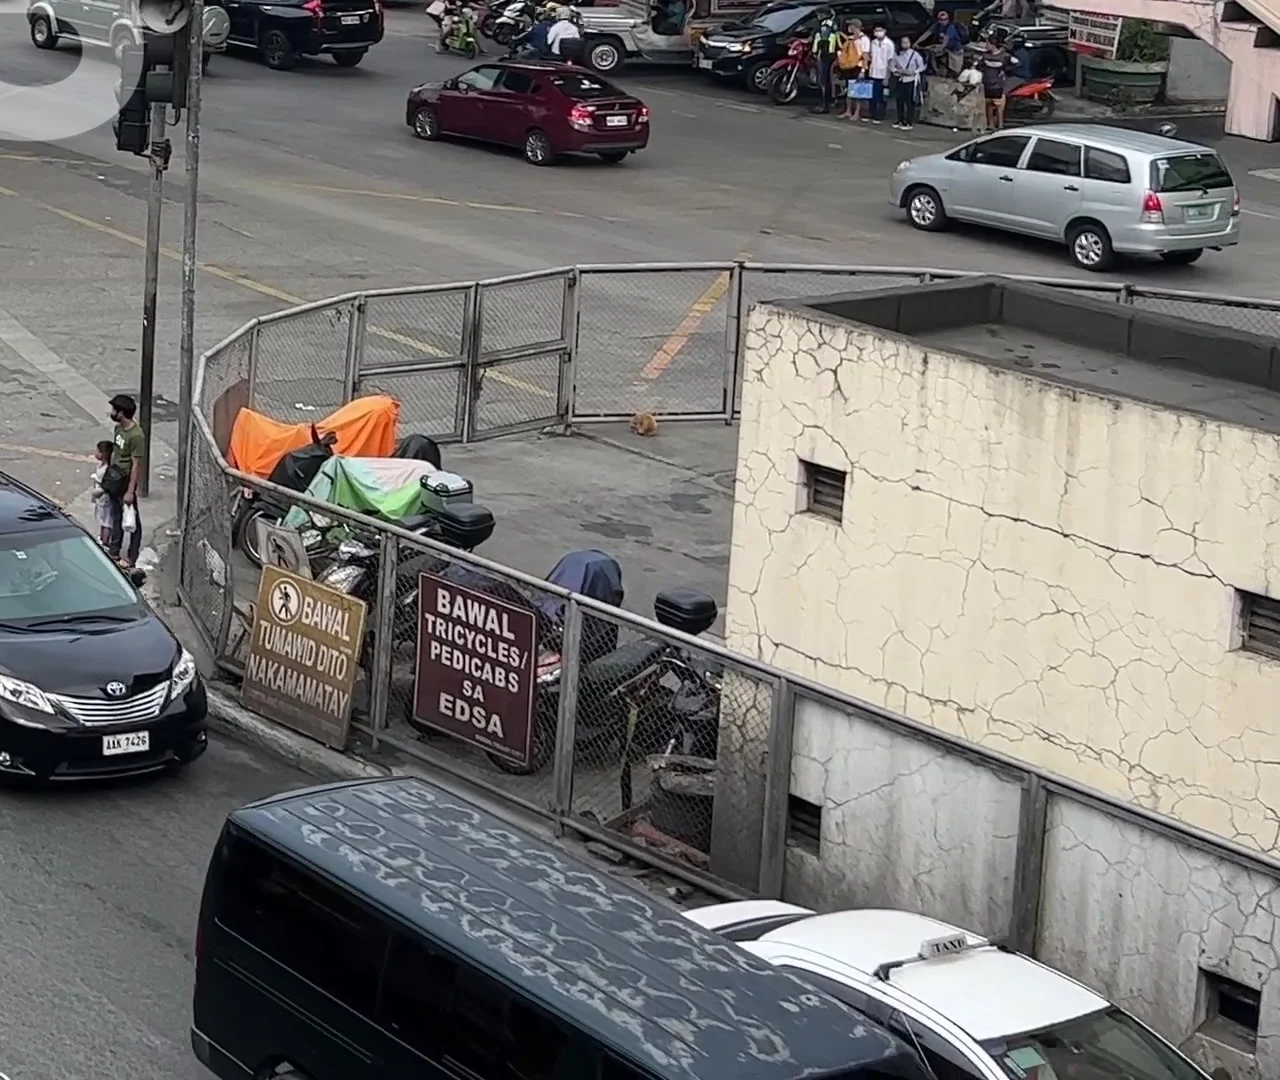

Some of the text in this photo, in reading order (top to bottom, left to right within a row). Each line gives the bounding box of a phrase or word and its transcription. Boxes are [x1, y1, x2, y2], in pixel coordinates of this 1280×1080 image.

[302, 596, 350, 642] BAWAL
[437, 588, 516, 640] BAWAL
[259, 620, 347, 680] TUMAWID DITO
[424, 613, 529, 670] TRICYCLES/
[430, 640, 520, 693] PEDICABS
[247, 653, 349, 719] NAKAMAMATAY
[462, 679, 485, 703] SA
[438, 691, 505, 738] EDSA
